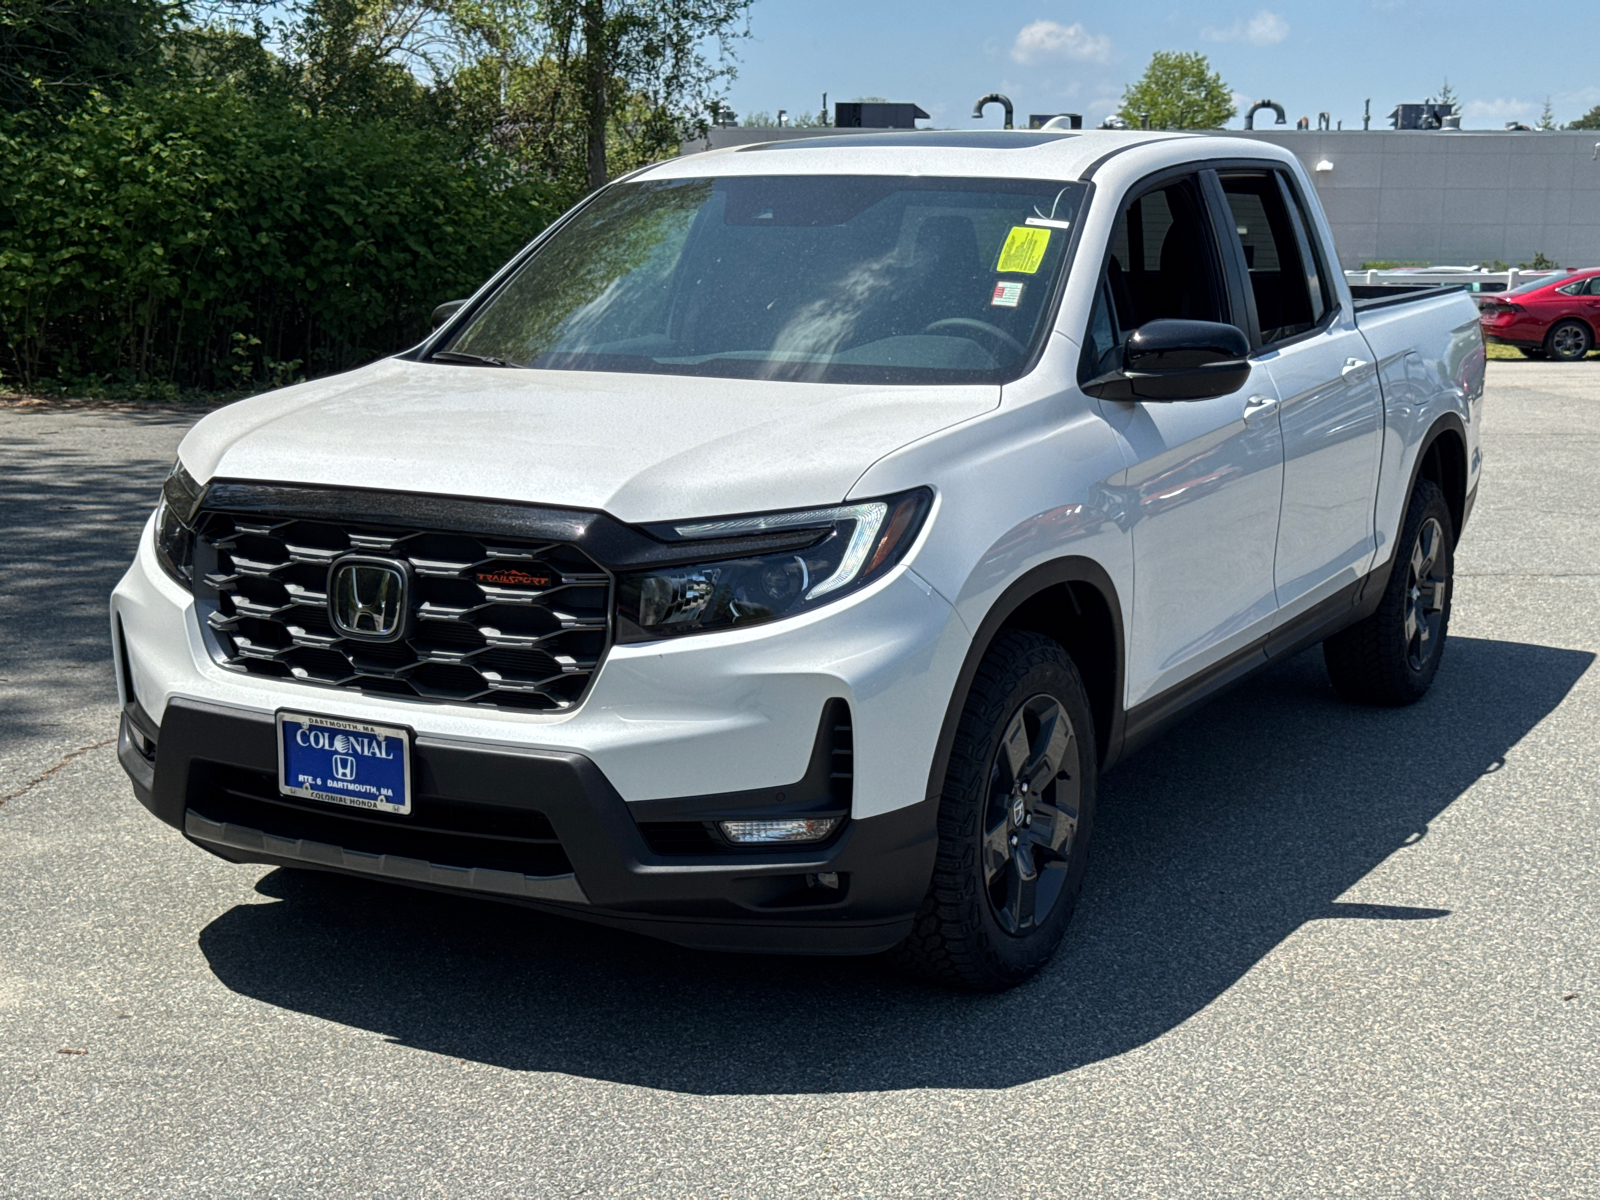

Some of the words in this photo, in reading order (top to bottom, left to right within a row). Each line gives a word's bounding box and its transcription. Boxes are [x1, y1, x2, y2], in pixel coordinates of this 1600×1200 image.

[477, 573, 549, 586] TRAILSPORT
[362, 725, 376, 733] MA
[296, 729, 393, 759] COLONIAL
[298, 774, 315, 784] RTE.
[316, 777, 322, 786] 6
[327, 779, 379, 795] DARTMOUTH,
[380, 787, 394, 797] MA
[310, 791, 348, 804] COLONIAL
[349, 799, 378, 809] HONDA
